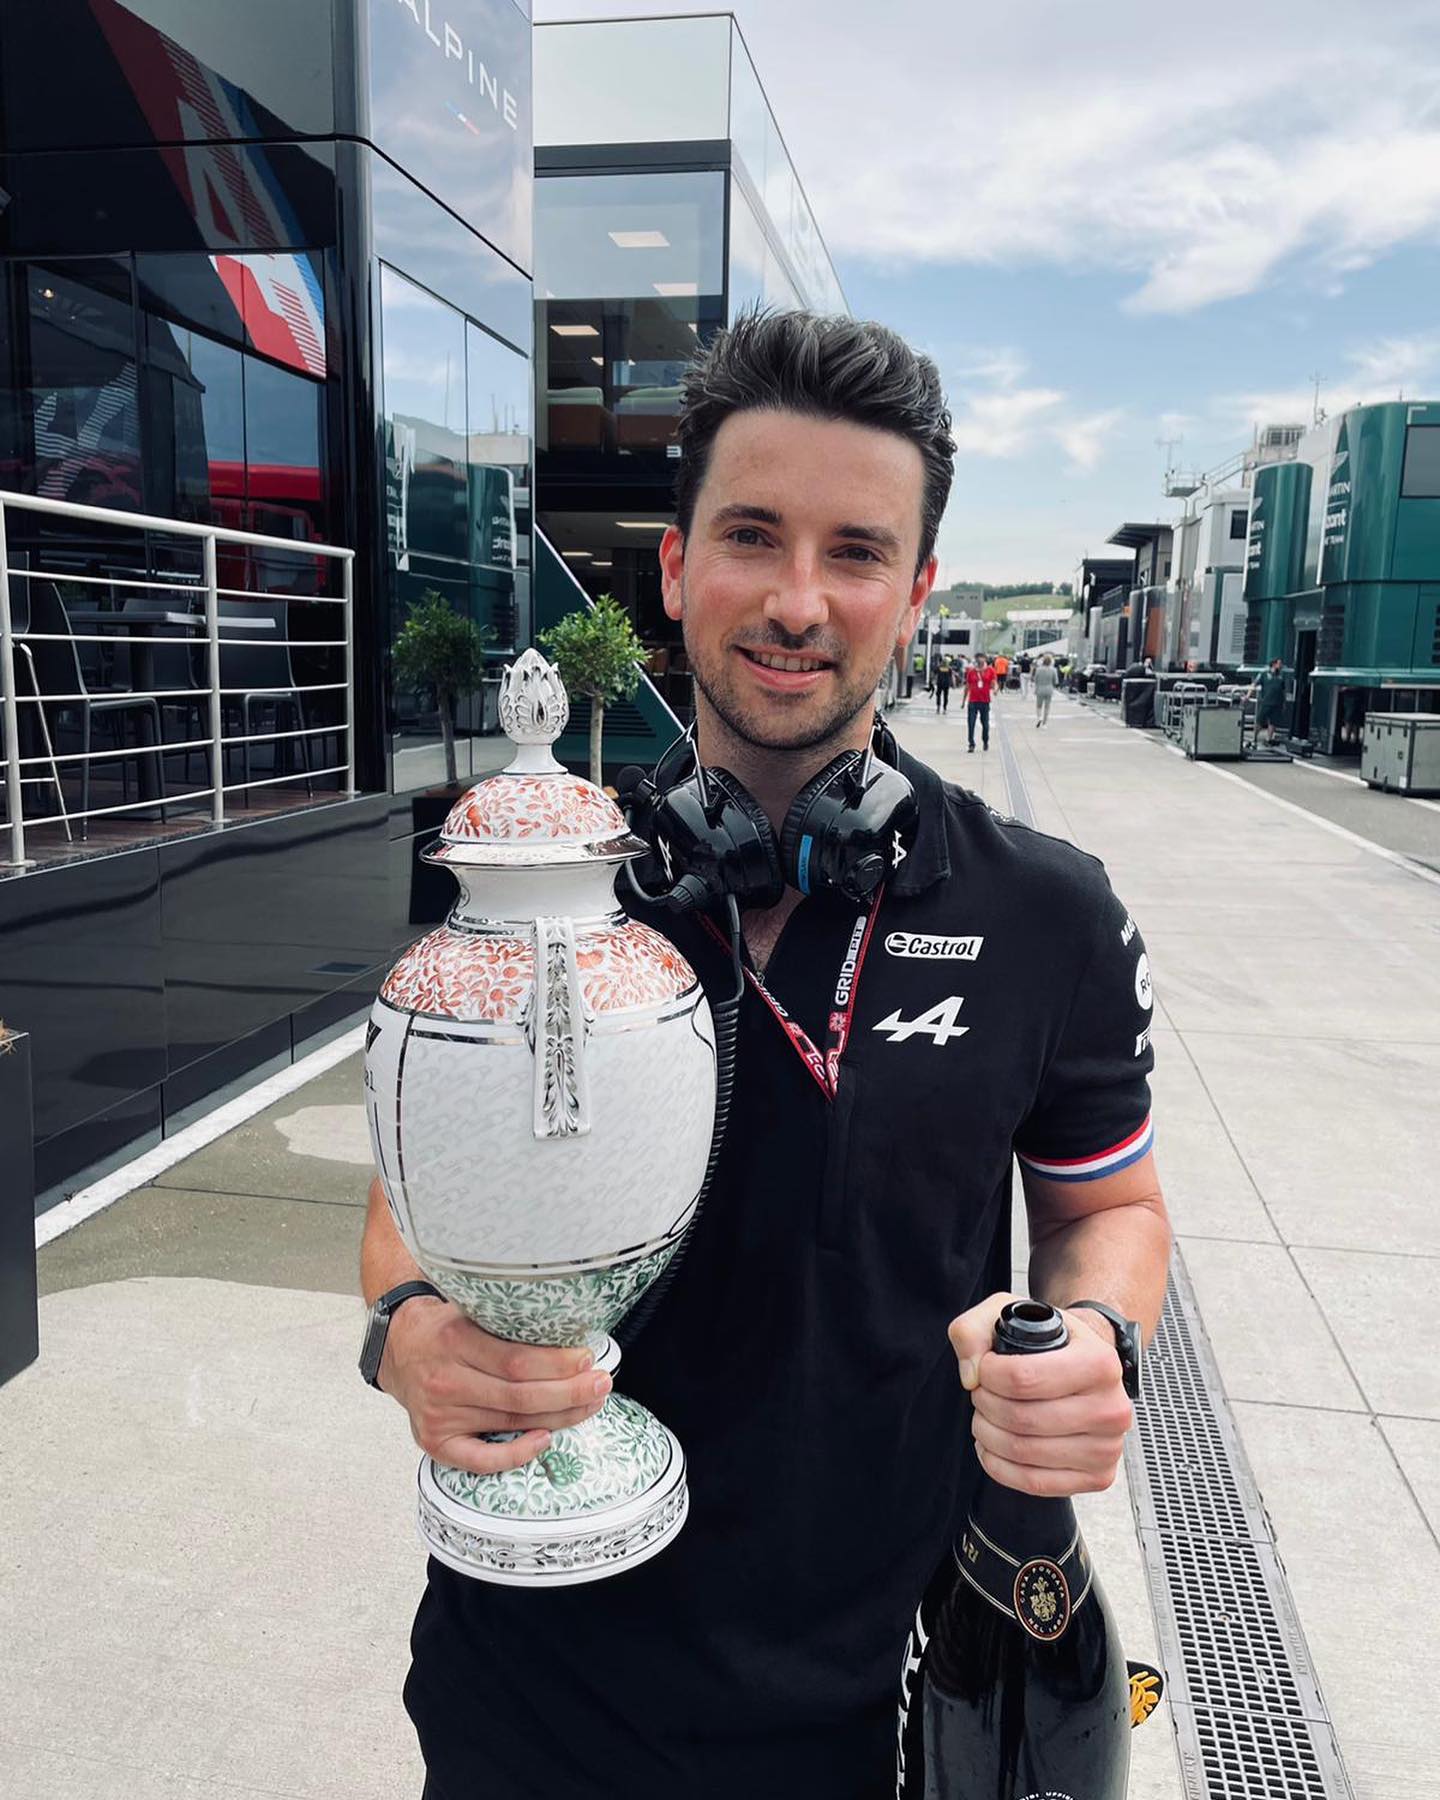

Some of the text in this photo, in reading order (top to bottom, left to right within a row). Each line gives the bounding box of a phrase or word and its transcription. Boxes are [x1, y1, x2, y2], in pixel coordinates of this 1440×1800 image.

[908, 937, 976, 956] Castrol
[834, 960, 857, 1006] GRID
[1032, 1566, 1065, 1599] FONDATA
